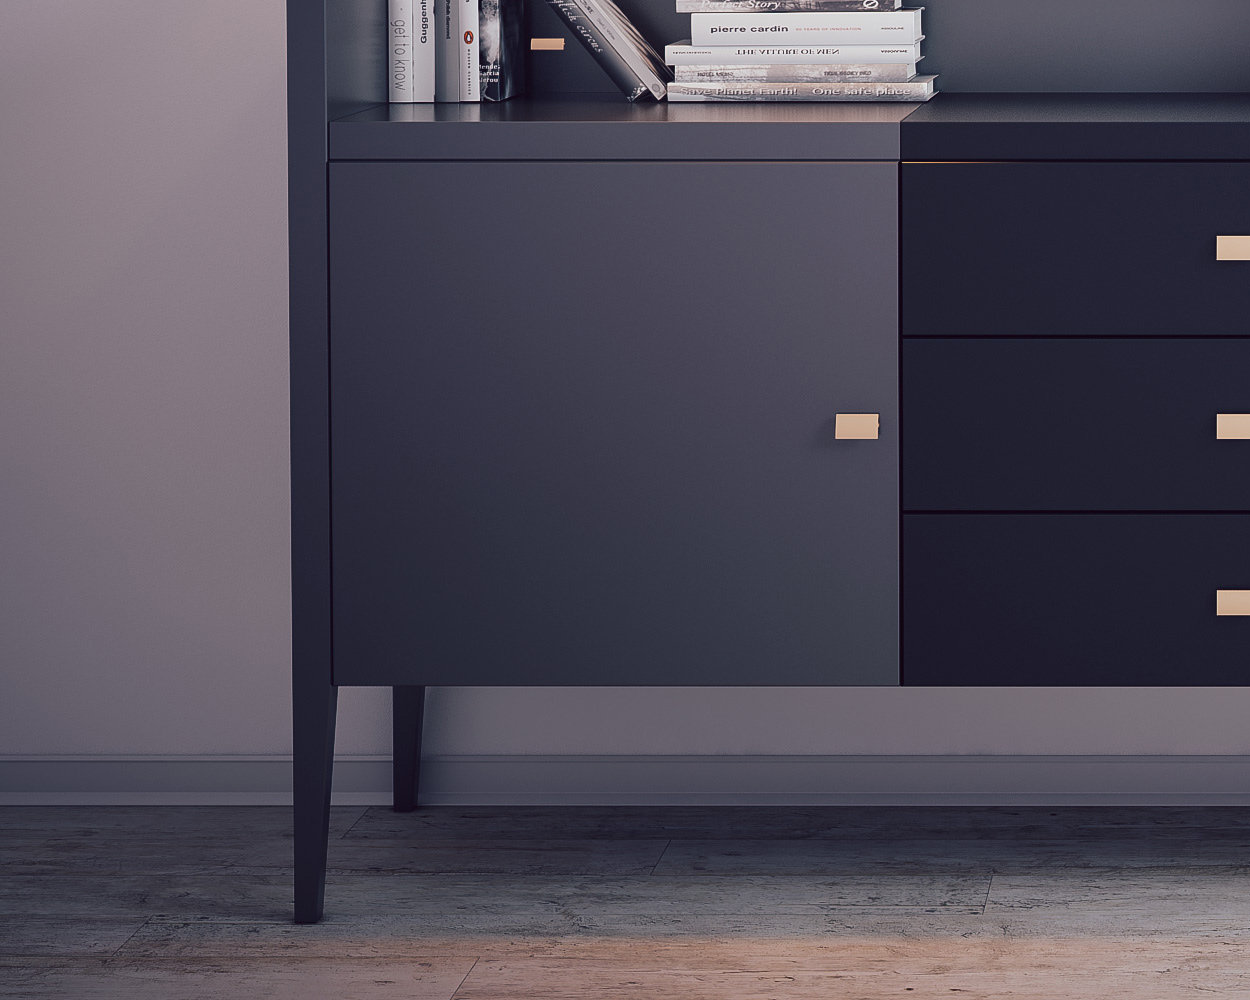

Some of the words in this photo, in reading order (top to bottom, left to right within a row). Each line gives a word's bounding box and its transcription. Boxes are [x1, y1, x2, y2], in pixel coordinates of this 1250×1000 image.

[746, 0, 781, 10] Story
[391, 19, 409, 39] get
[710, 26, 747, 34] pierre
[750, 25, 789, 33] cardin
[391, 43, 409, 56] to
[391, 59, 409, 91] know
[680, 87, 713, 96] Save
[716, 87, 757, 96] Planet
[759, 87, 799, 96] Earth!
[811, 87, 842, 96] One
[844, 87, 873, 96] safe
[875, 87, 912, 97] place
